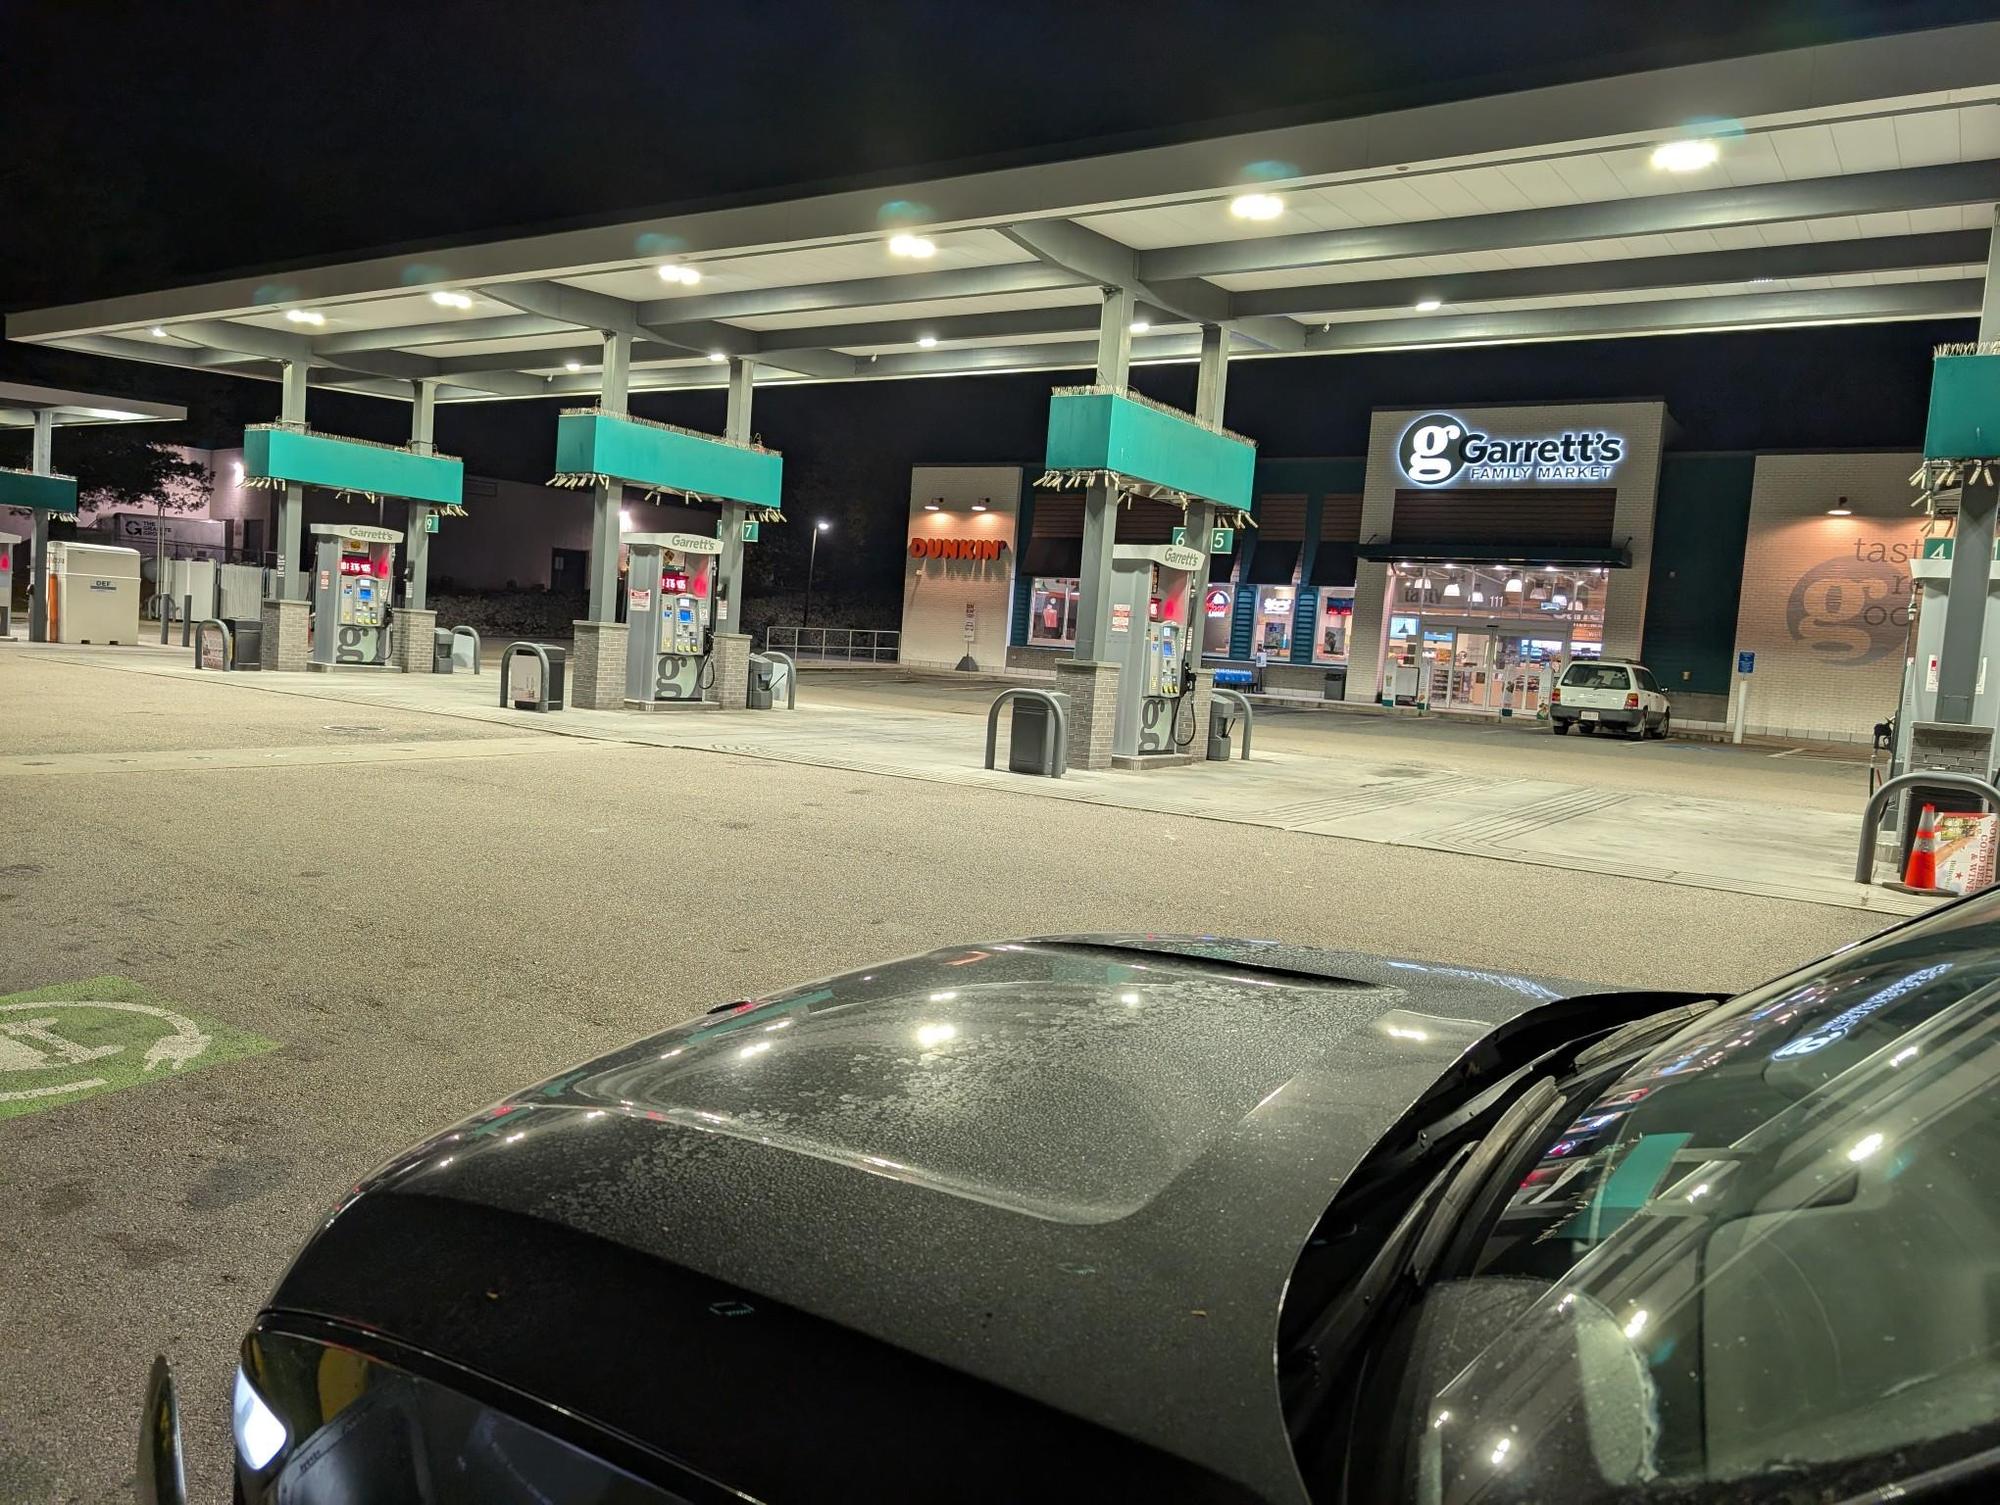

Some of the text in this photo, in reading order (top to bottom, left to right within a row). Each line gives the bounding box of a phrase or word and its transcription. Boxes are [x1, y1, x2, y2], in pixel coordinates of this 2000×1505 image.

[1408, 425, 1461, 482] g
[1458, 432, 1623, 464] Garrett's
[1471, 466, 1611, 479] FAMILY MARKET
[349, 527, 393, 541] Garrett's
[671, 534, 715, 551] Garrett's
[744, 525, 753, 538] 7
[1176, 531, 1185, 546] 6
[1214, 532, 1225, 548] 5
[910, 538, 1007, 560] DUNKIN'
[1164, 547, 1199, 567] Garrett's
[1854, 538, 1923, 563] tast
[1929, 543, 1946, 559] 4
[1489, 595, 1504, 608] 111
[336, 626, 370, 662] g
[655, 655, 688, 698] g
[1138, 699, 1166, 751] g
[1979, 834, 1988, 862] COLD
[1985, 820, 1998, 886] NOW SELLIN
[1965, 863, 1978, 893] WINE
